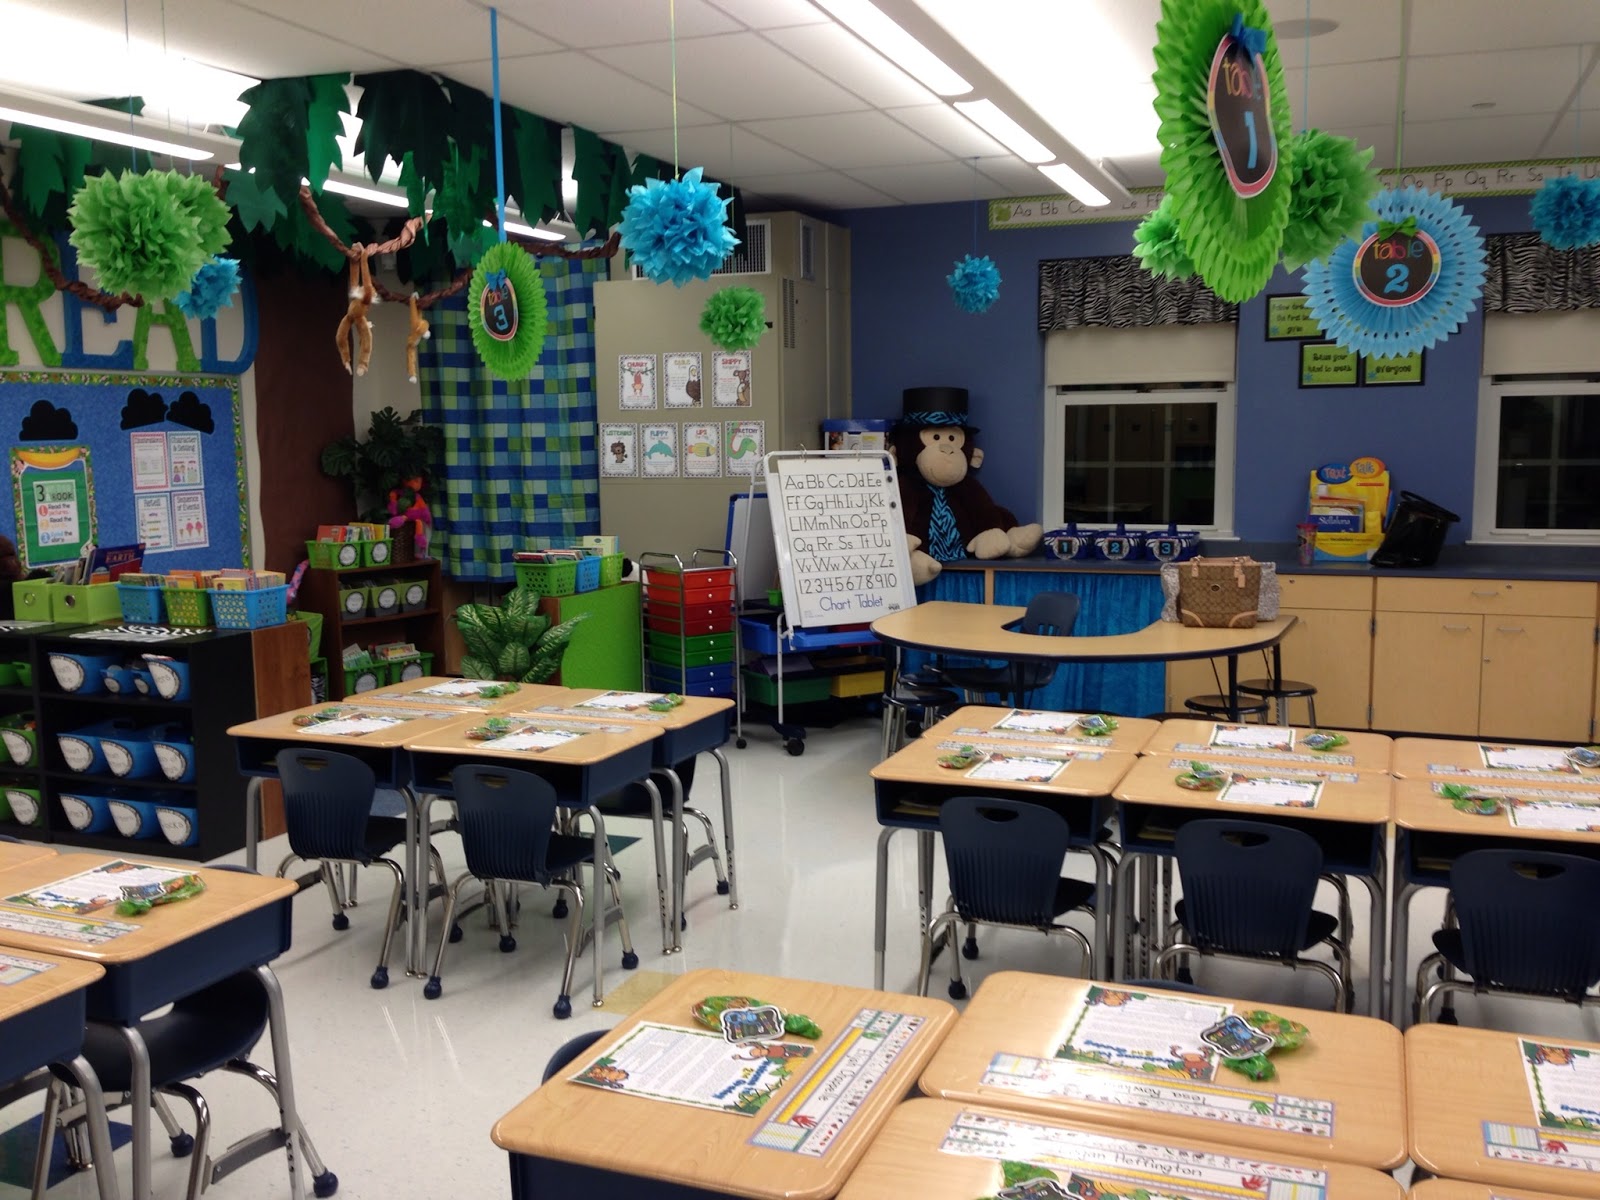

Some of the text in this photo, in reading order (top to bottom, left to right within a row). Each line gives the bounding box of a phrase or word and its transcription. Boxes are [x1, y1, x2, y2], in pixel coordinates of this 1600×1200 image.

[1244, 111, 1258, 169] 1
[1012, 203, 1032, 217] Aa
[1040, 201, 1059, 216] Bb
[1434, 172, 1454, 191] Pp
[1527, 167, 1544, 182] Ss
[1373, 238, 1425, 260] table
[1383, 263, 1410, 294] 2
[493, 304, 509, 331] 3
[1354, 462, 1375, 474] Talk
[785, 472, 882, 490] Aa Bb Cc Dd Ee
[36, 484, 46, 502] 3
[787, 492, 886, 516] Ff Gg Hh Ii Jj Kk
[789, 513, 888, 533] Ll Mm Nn Oo Pp
[793, 533, 891, 558] Qq Rr Ss Tt Uu
[1062, 542, 1068, 552] 1
[1111, 542, 1120, 553] 2
[1161, 542, 1171, 554] 3
[795, 553, 895, 575] Vv Ww Xx Yy Zz
[820, 596, 851, 612] Chart
[854, 593, 884, 609] Tablet
[1114, 1150, 1203, 1176] Heffington
